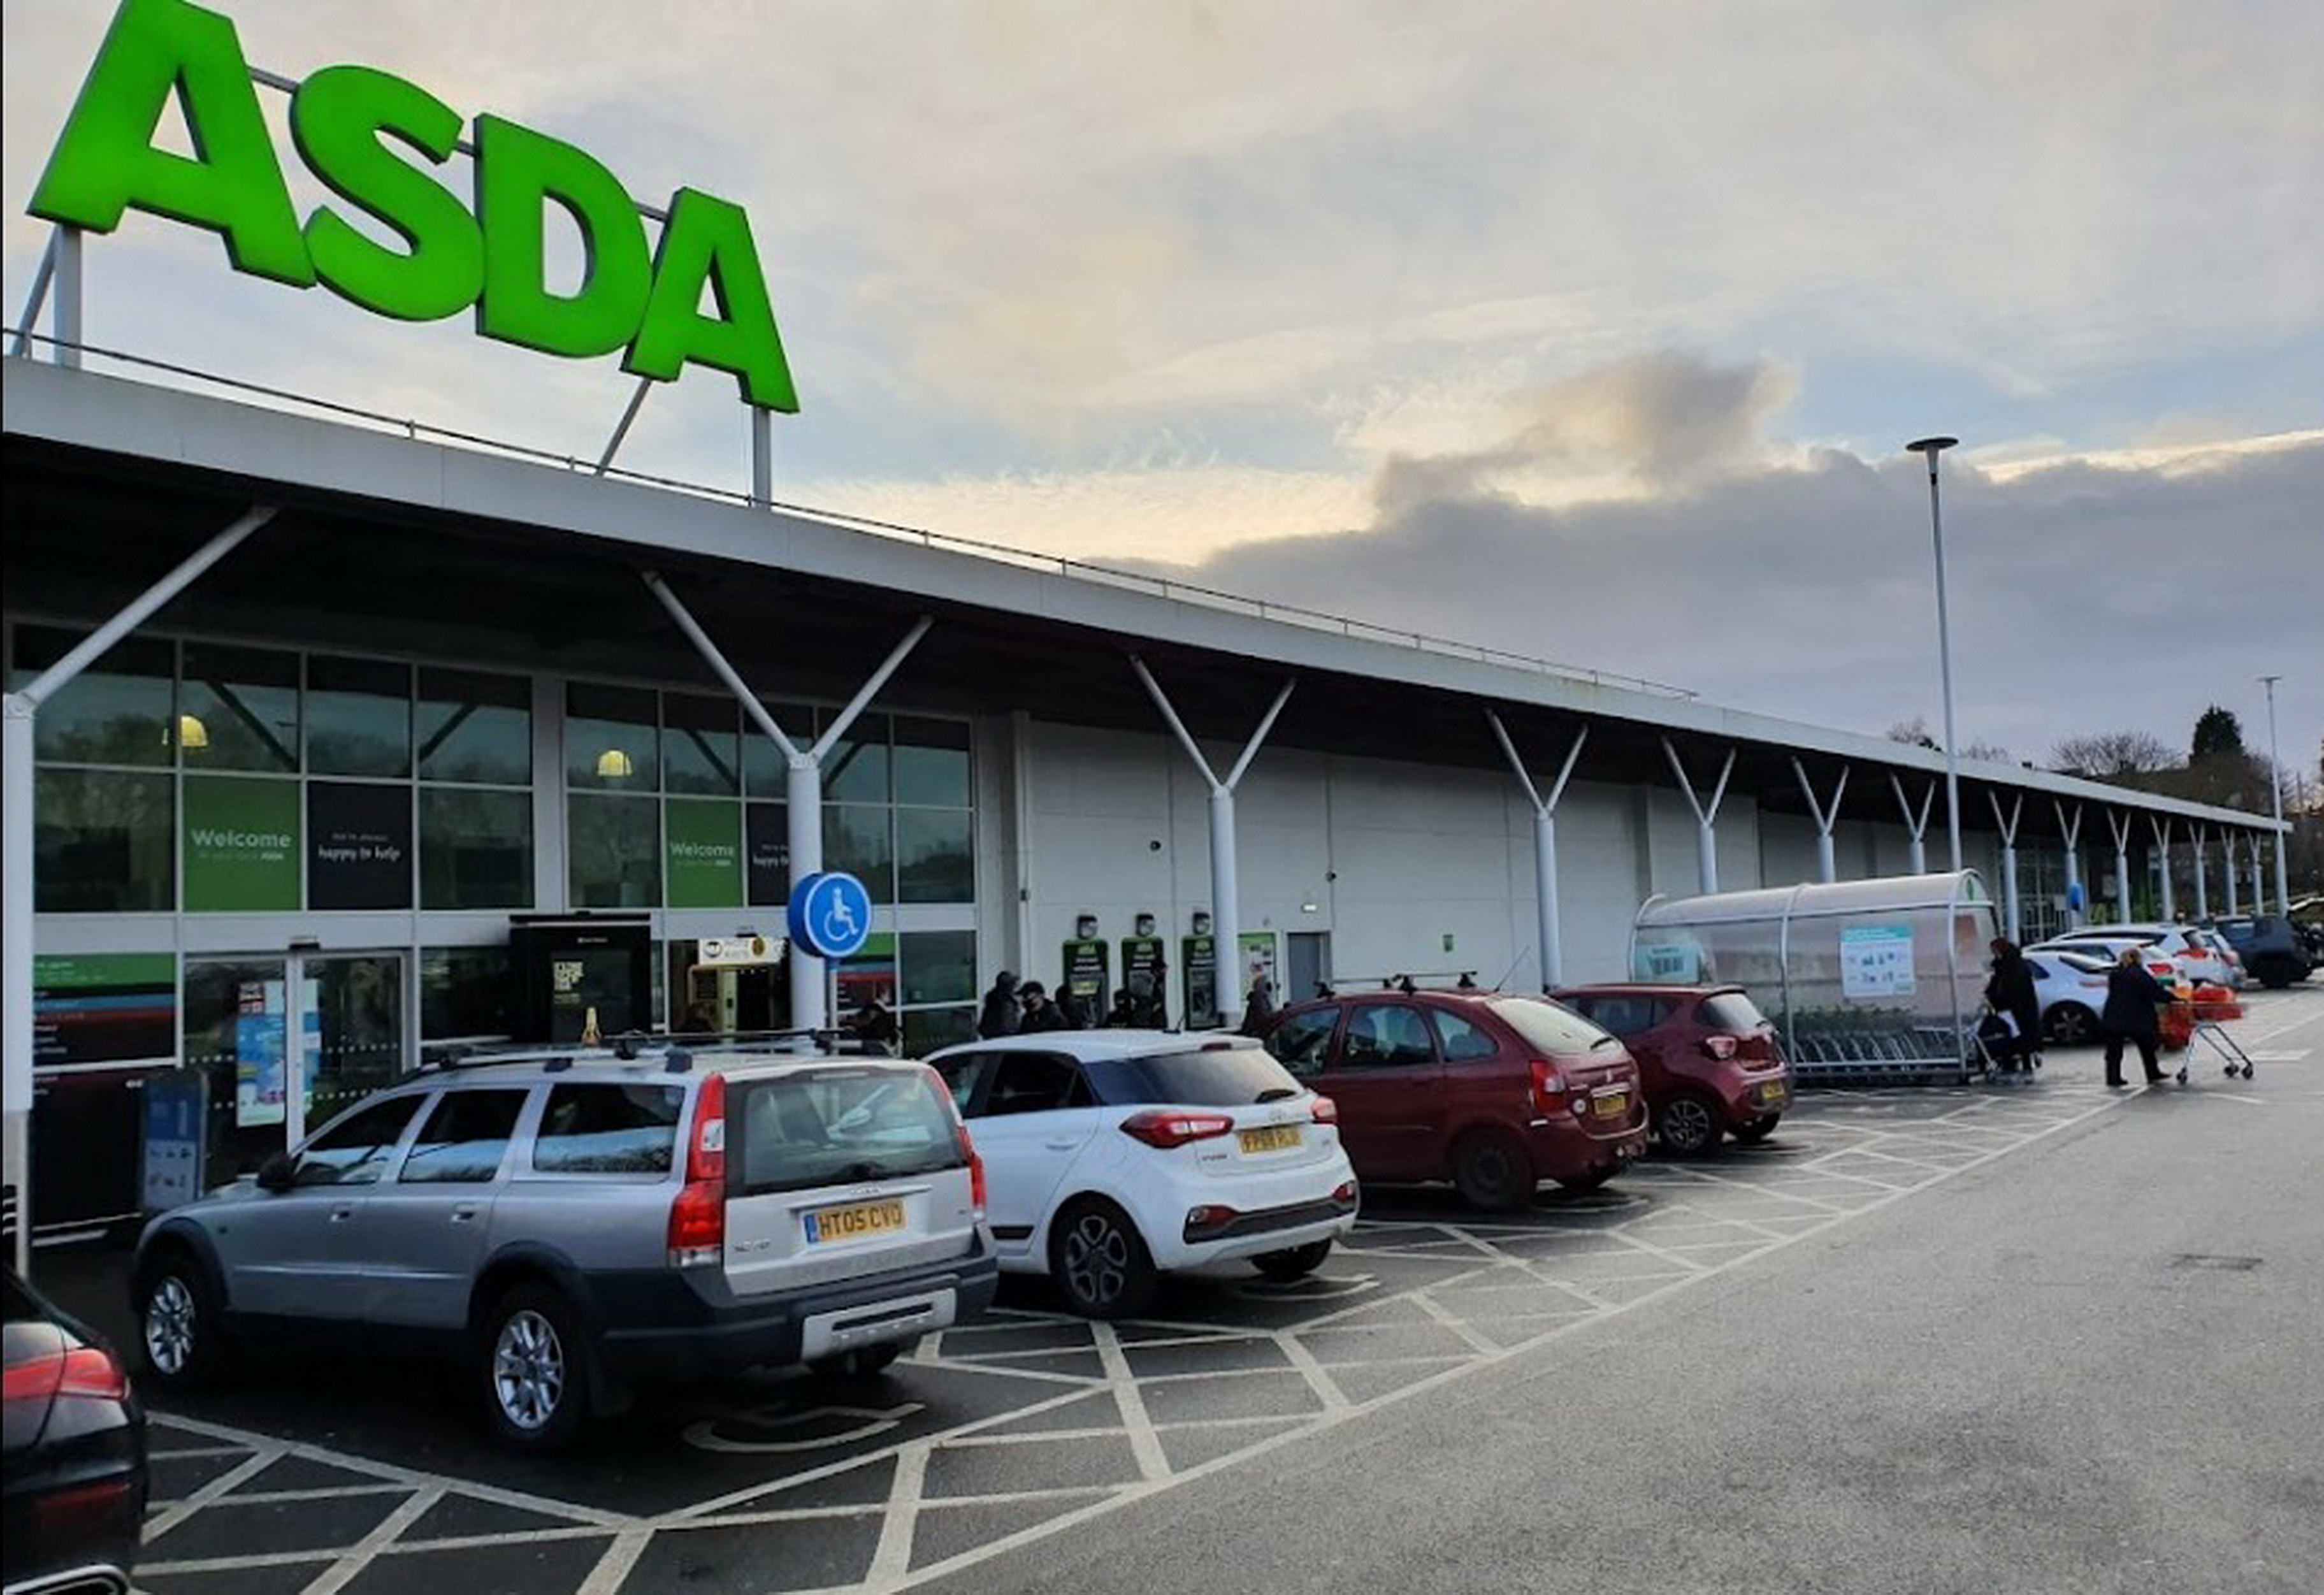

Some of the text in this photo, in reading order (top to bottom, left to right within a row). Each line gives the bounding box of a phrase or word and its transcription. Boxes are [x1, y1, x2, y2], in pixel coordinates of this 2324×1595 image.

[25, 0, 799, 412] ASDA
[191, 829, 292, 848] Welcome
[319, 844, 357, 861] happy
[374, 846, 401, 862] help
[670, 841, 735, 857] Welcome
[819, 1209, 866, 1236] HT05
